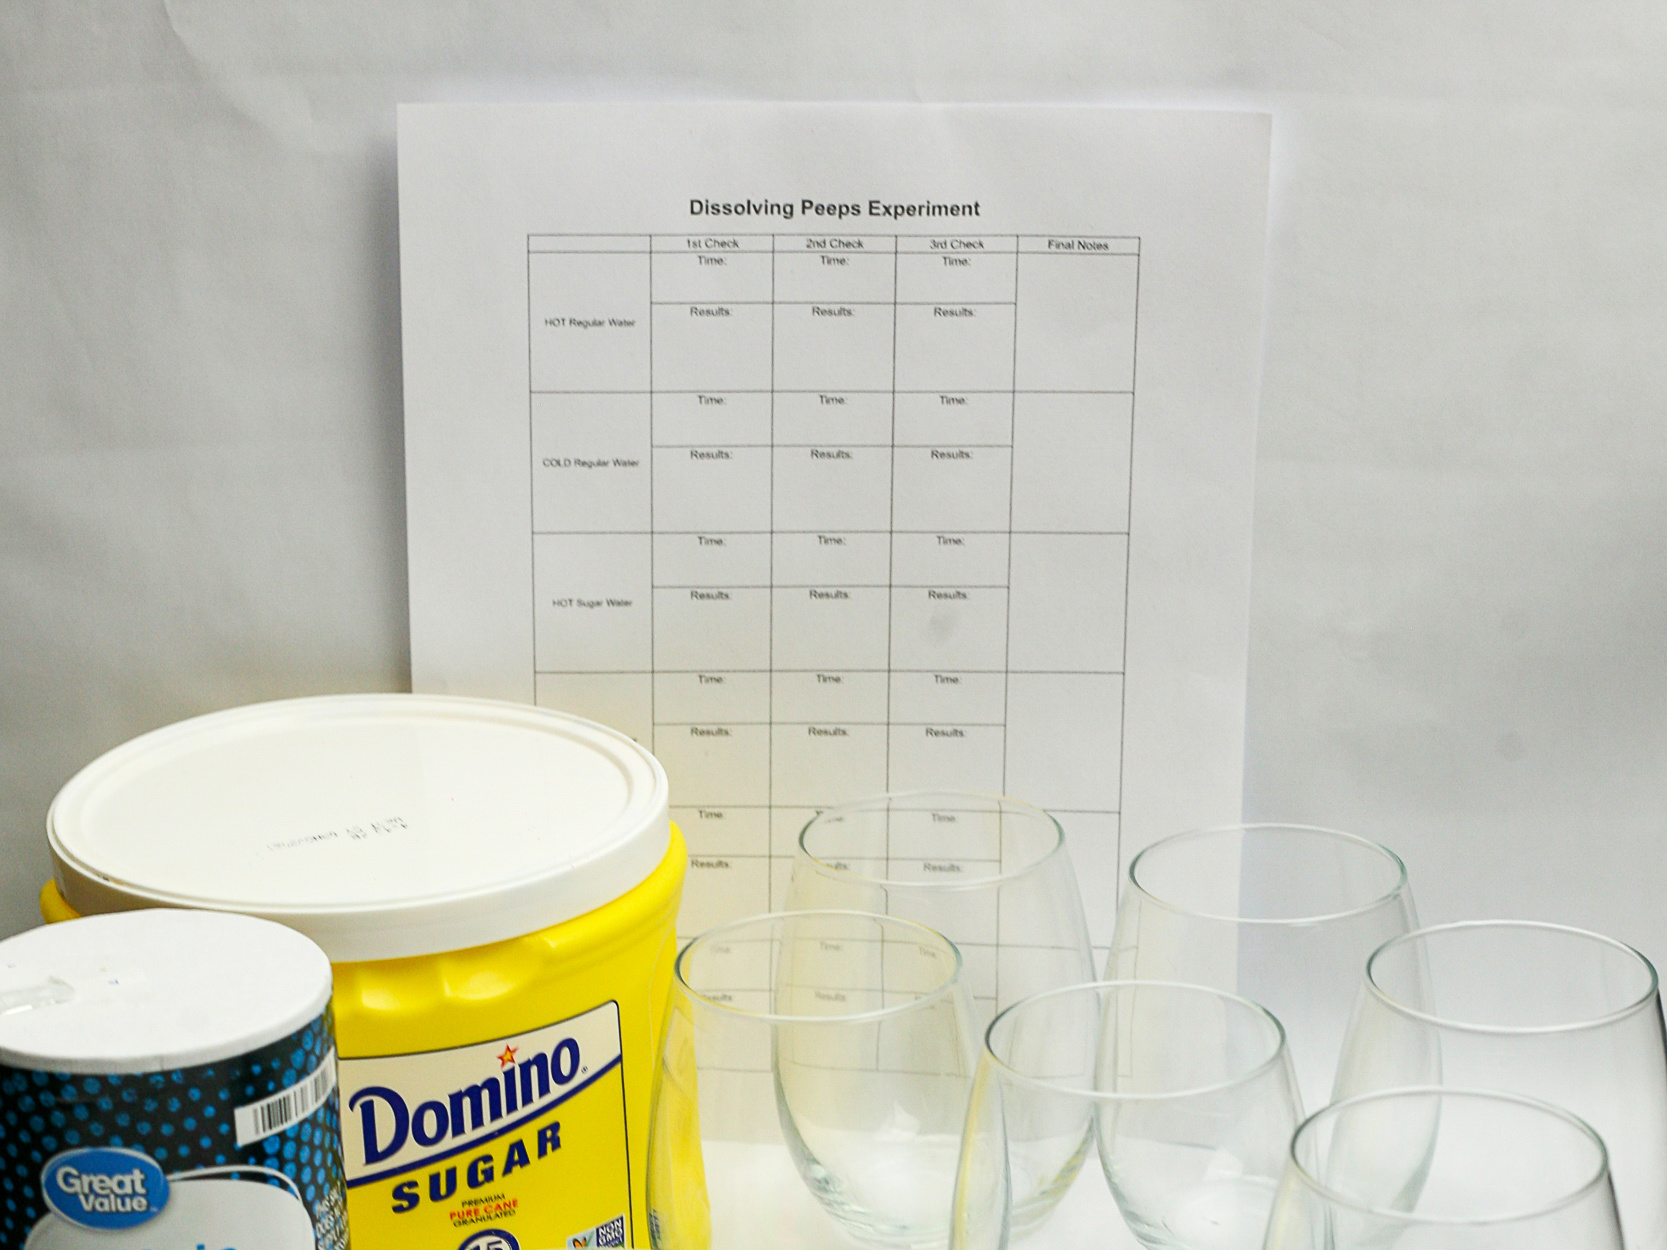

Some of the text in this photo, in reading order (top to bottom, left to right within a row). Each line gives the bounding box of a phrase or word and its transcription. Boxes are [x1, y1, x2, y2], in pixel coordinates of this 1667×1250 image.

[689, 198, 981, 221] Dissolving Peeps Experiment
[686, 238, 740, 249] 1st Check
[805, 238, 864, 249] 2nd Check
[929, 239, 985, 250] 3rd Check
[1047, 239, 1109, 251] Final Notes
[544, 317, 636, 330] HOT Regular Water
[542, 458, 640, 469] COLD Regular Water
[552, 598, 633, 609] HOT Sugar Water
[349, 1038, 580, 1166] Domino
[391, 1121, 562, 1214] SUGAR
[56, 1166, 146, 1195] Great
[78, 1194, 148, 1212] Value
[449, 1198, 518, 1220] PURE CANE
[461, 1193, 506, 1208] PREMIUM
[453, 1209, 516, 1227] GRANULATED
[598, 1218, 622, 1236] NON
[598, 1228, 623, 1246] GMO
